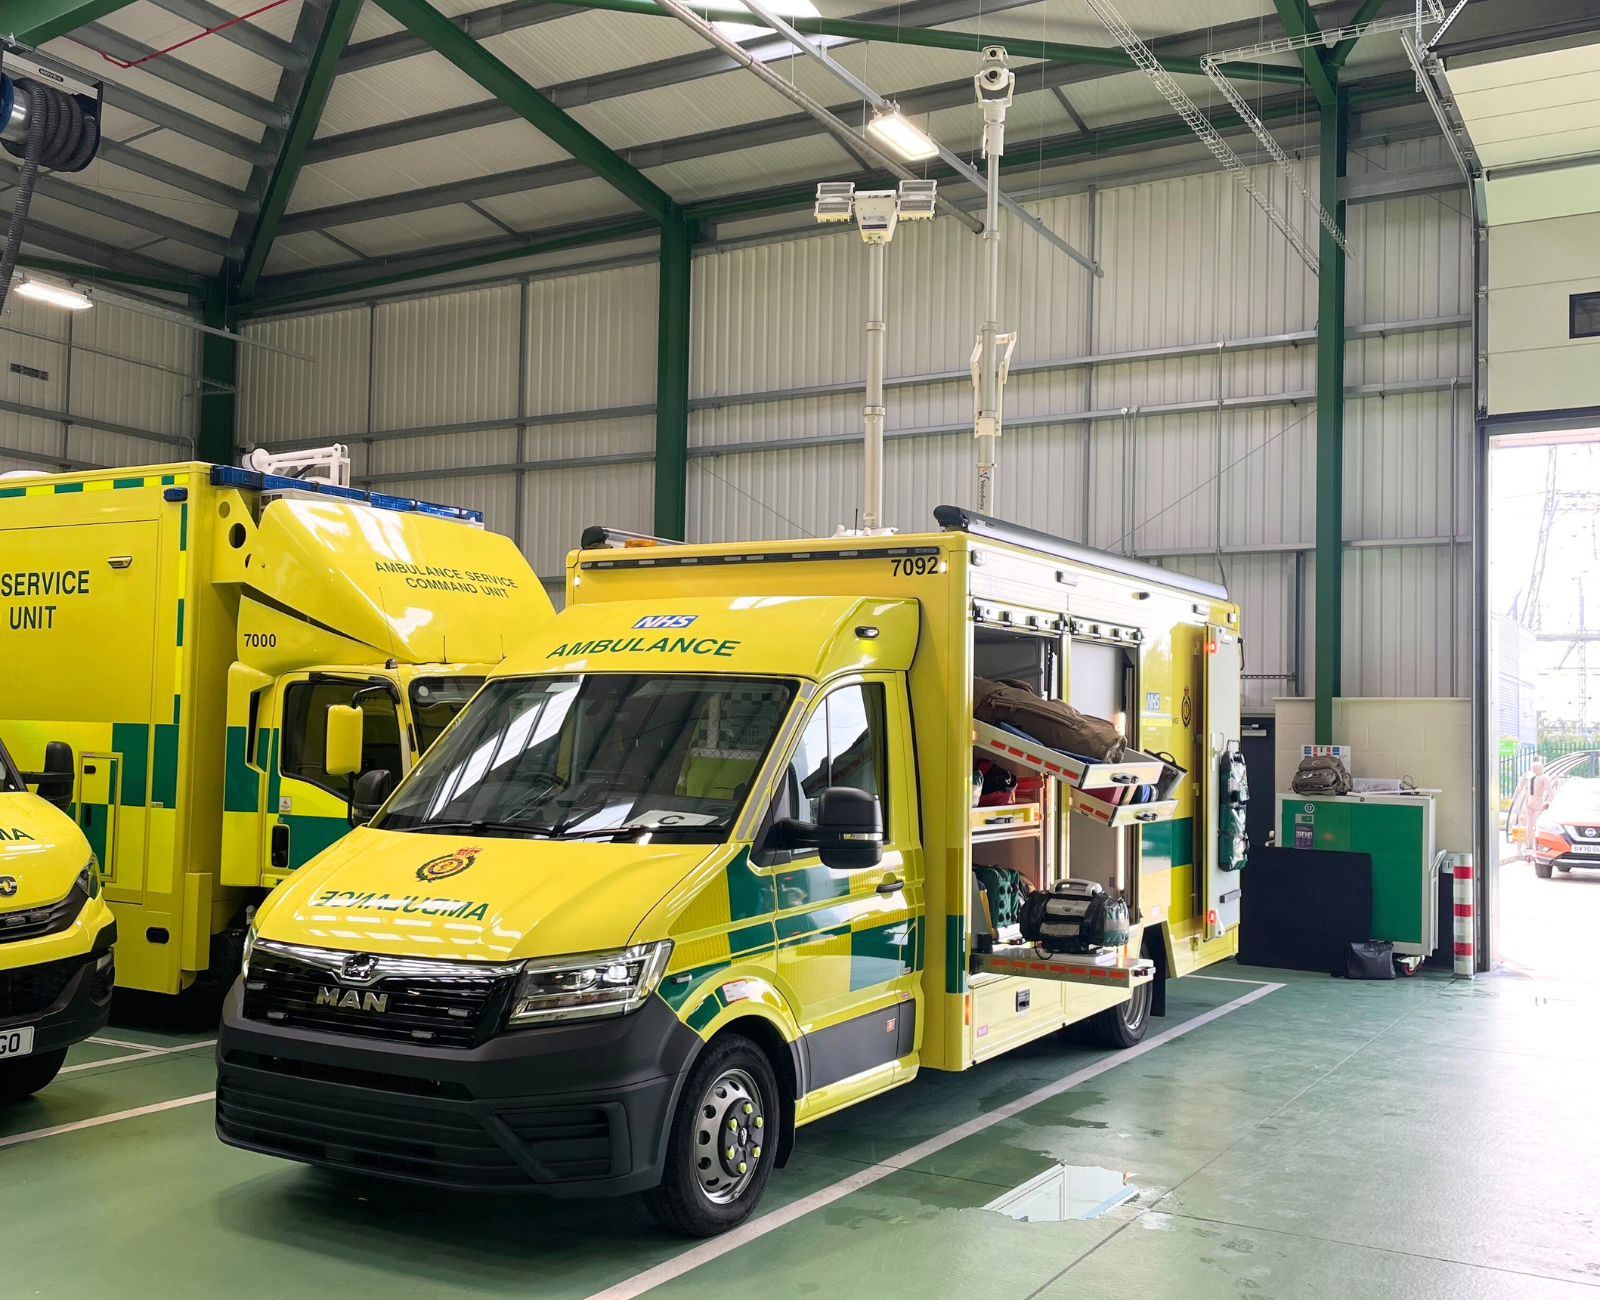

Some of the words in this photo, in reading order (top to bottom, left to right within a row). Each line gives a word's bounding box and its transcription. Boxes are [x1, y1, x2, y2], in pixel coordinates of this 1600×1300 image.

[375, 561, 463, 579] AMBULANCE
[464, 571, 518, 589] SERVICE
[891, 556, 938, 577] 7092
[0, 570, 90, 597] SERVICE
[405, 577, 478, 594] COMMAND
[479, 584, 510, 599] UNIT
[9, 605, 57, 630] UNIT
[632, 615, 697, 628] NHS
[243, 633, 277, 648] 7000
[545, 637, 742, 659] AMBULANCE
[1147, 693, 1160, 710] NHS
[657, 815, 685, 825] C
[316, 986, 388, 1013] MAN
